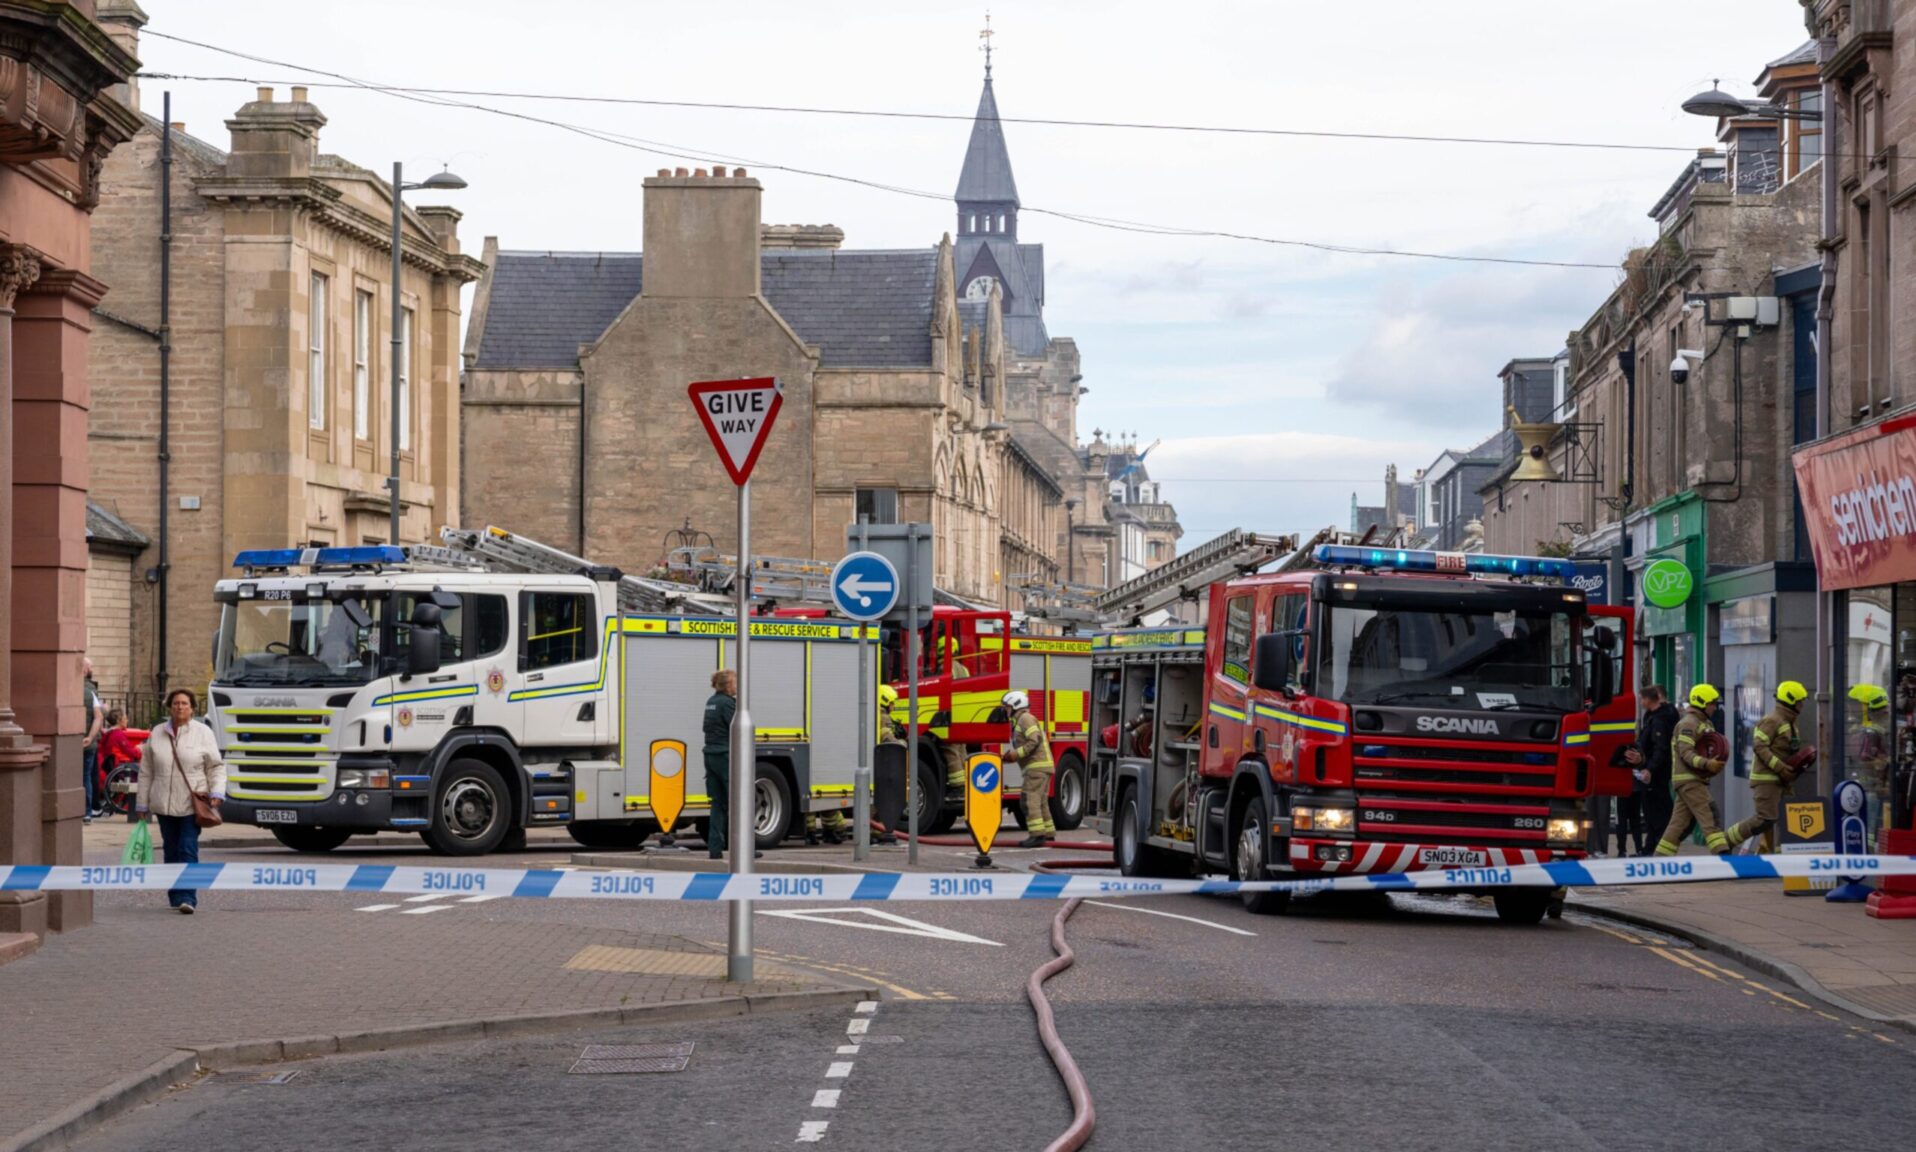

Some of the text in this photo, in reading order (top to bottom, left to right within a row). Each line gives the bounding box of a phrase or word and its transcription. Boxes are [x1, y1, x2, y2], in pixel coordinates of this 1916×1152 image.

[708, 392, 764, 414] GIVE
[721, 419, 756, 434] WAY
[1831, 470, 1916, 546] semichem
[1437, 555, 1466, 569] FIRE
[1651, 570, 1688, 590] VPZ
[688, 621, 732, 634] SCOTTISH
[753, 623, 760, 635] &
[762, 623, 795, 636] RESCUE
[797, 624, 831, 637] SERVICE
[254, 696, 298, 707] SCANIA
[1416, 716, 1500, 735] SCANIA
[1514, 817, 1544, 828] 260
[1424, 850, 1480, 864] SN03 XGA
